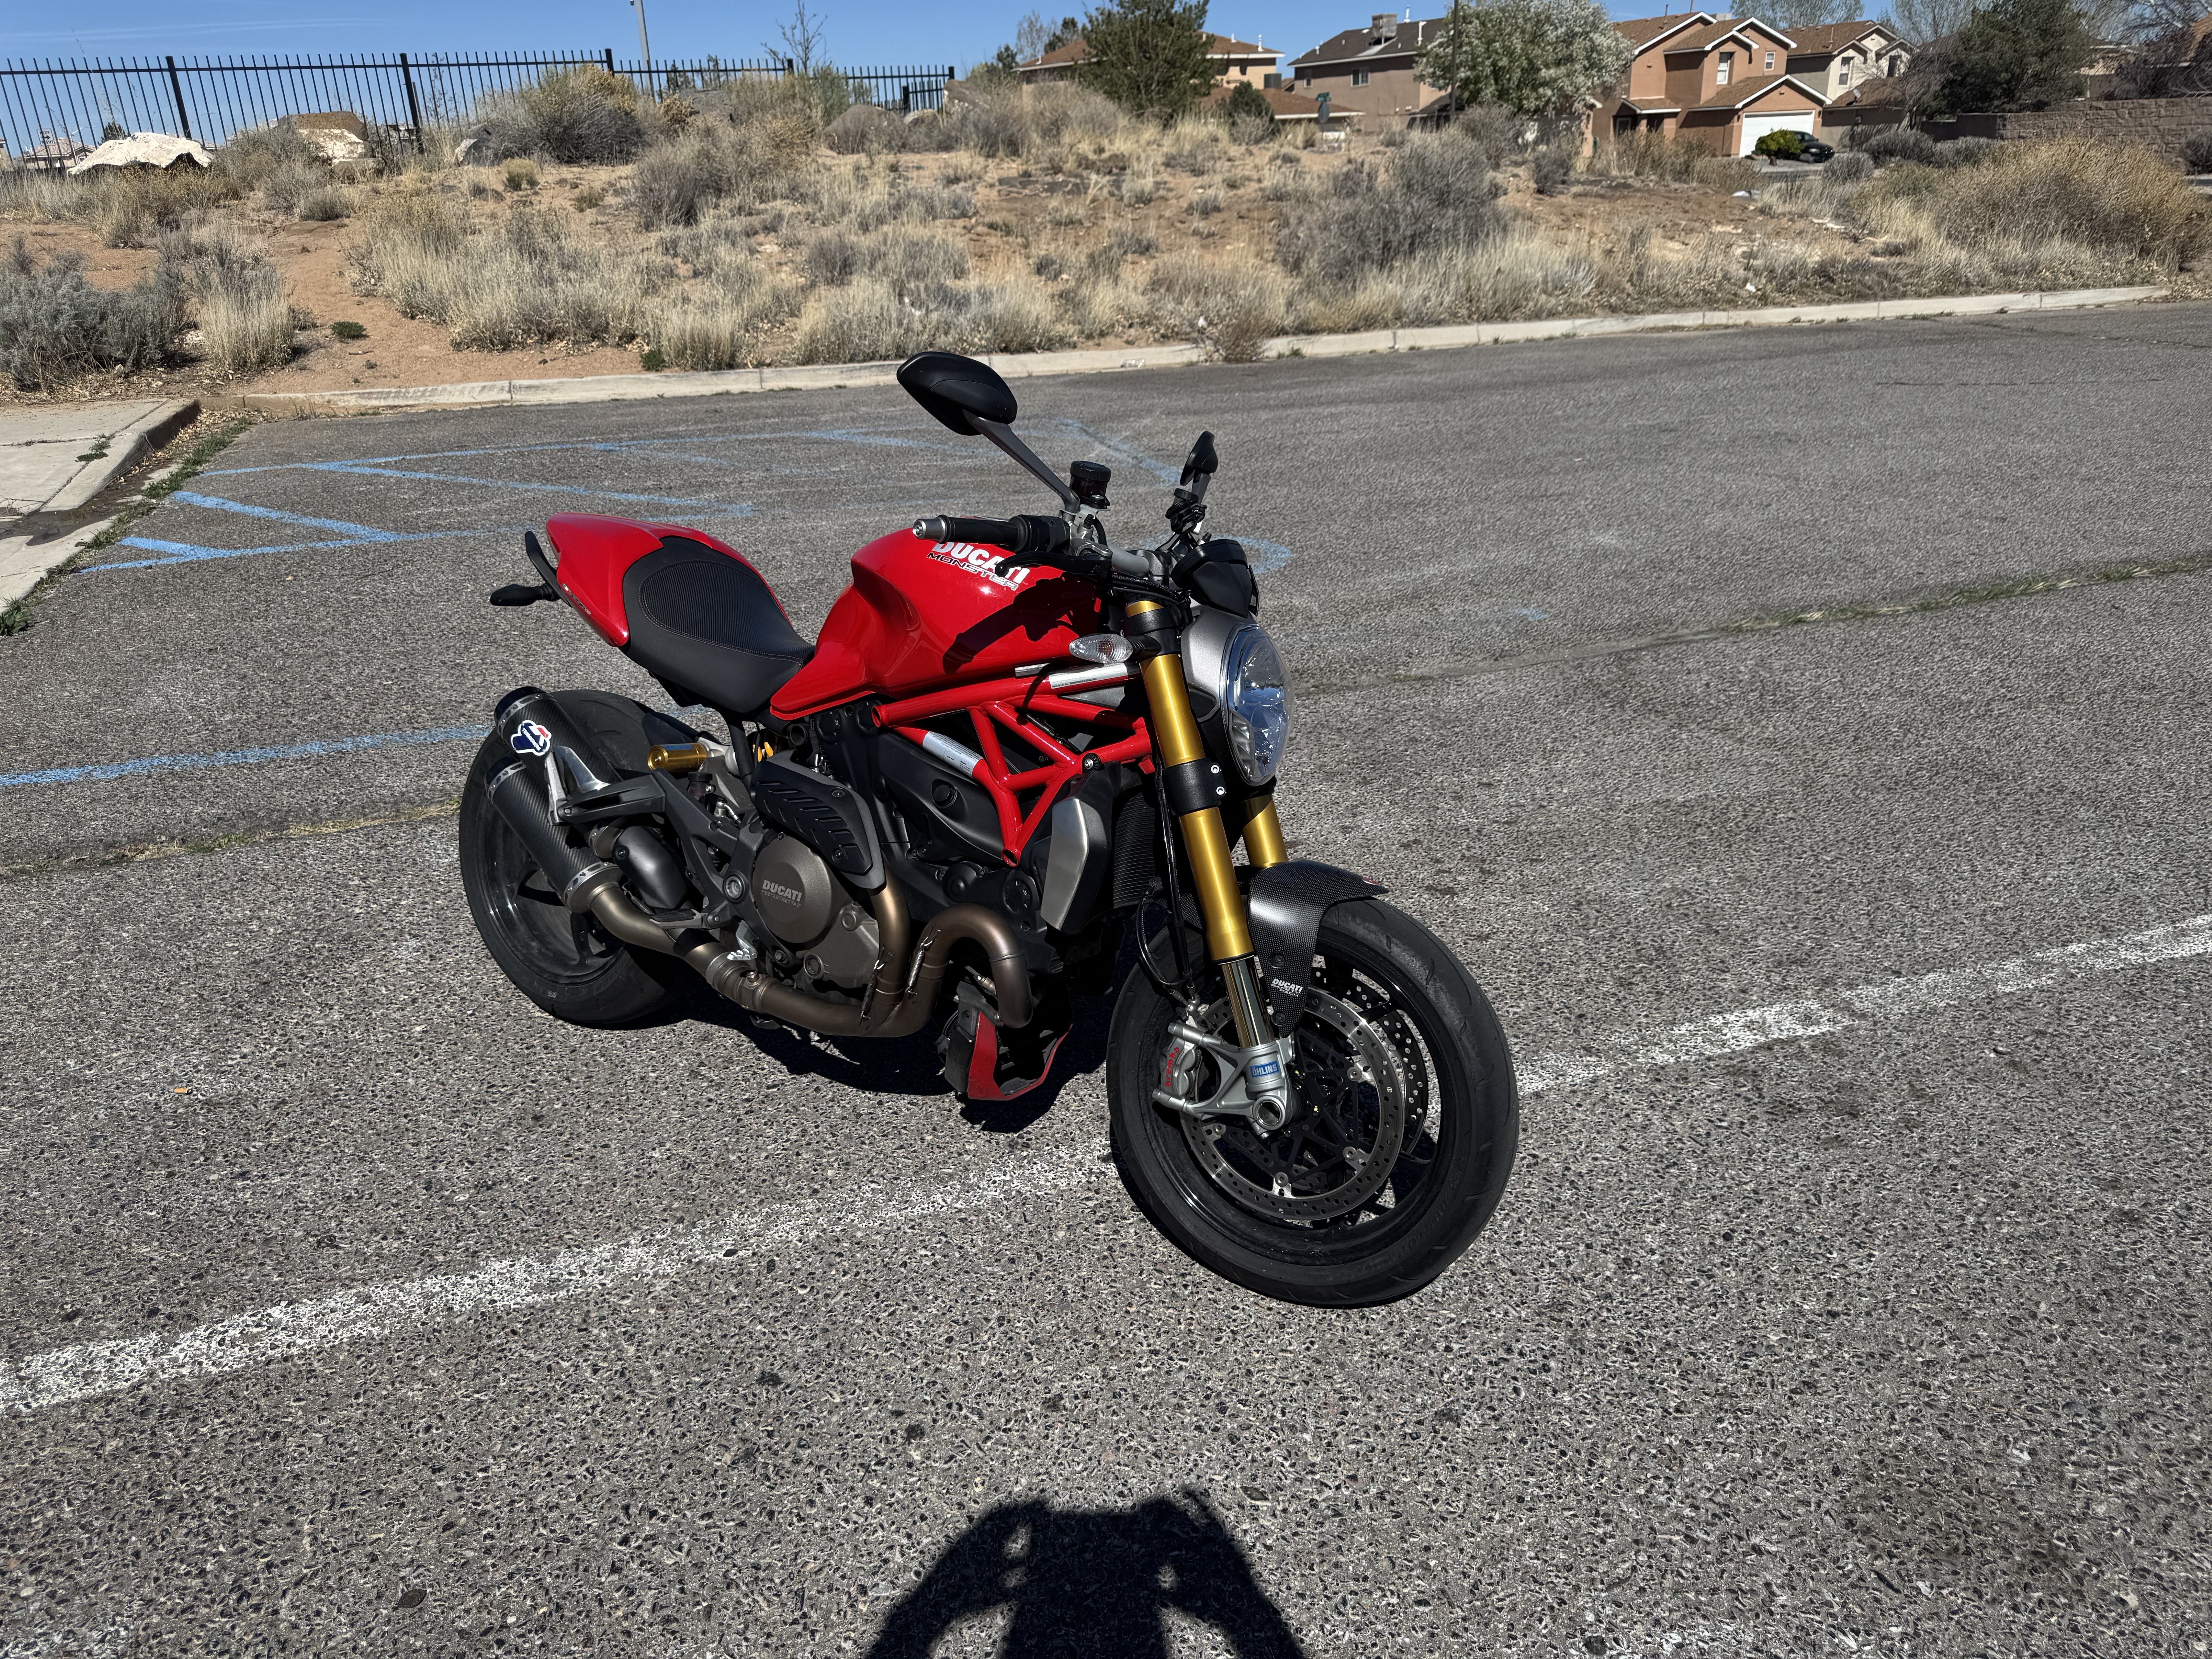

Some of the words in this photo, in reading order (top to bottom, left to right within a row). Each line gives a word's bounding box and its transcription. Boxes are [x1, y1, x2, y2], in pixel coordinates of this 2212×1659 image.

[926, 552, 1019, 591] MONSTER
[931, 542, 1030, 584] DUCATI
[762, 880, 802, 902] DUCATI
[762, 890, 796, 906] TESTASTRETTA
[1272, 978, 1303, 992] DUCATI
[1164, 1047, 1179, 1087] brembo
[1251, 1064, 1278, 1076] ÖHLINS
